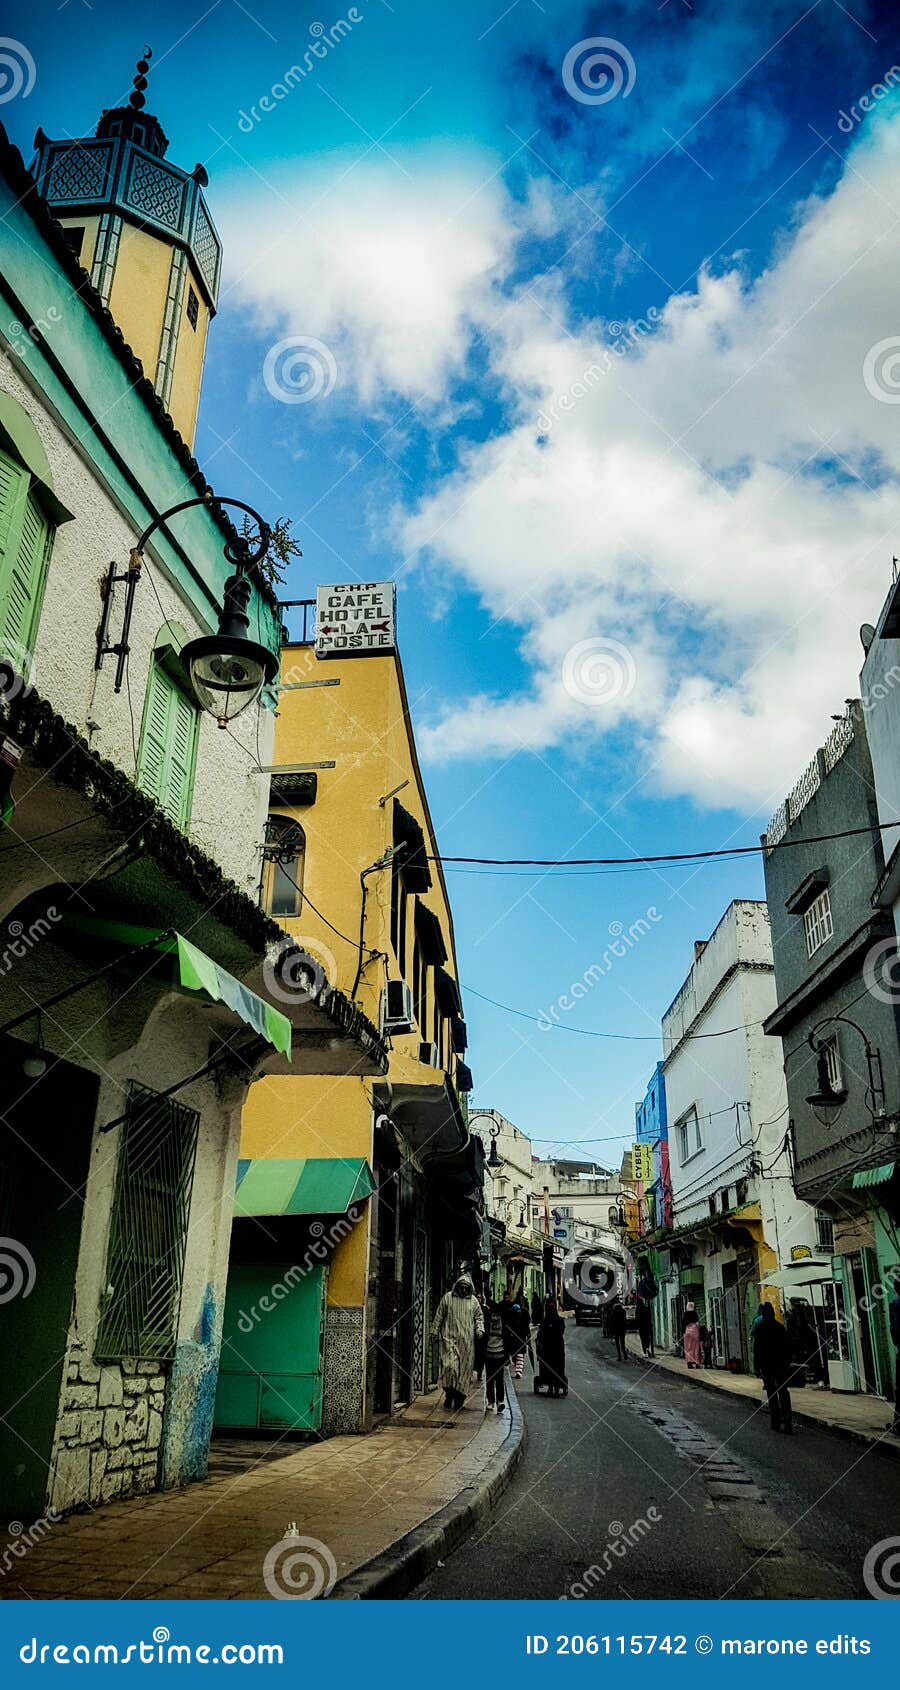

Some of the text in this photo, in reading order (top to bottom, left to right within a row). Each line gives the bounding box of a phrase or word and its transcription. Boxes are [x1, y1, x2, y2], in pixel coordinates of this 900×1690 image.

[328, 593, 383, 608] CAFE
[320, 607, 390, 622] HOTEL
[340, 623, 369, 635] LA
[319, 633, 390, 649] POSTE
[635, 1144, 643, 1179] CYBER
